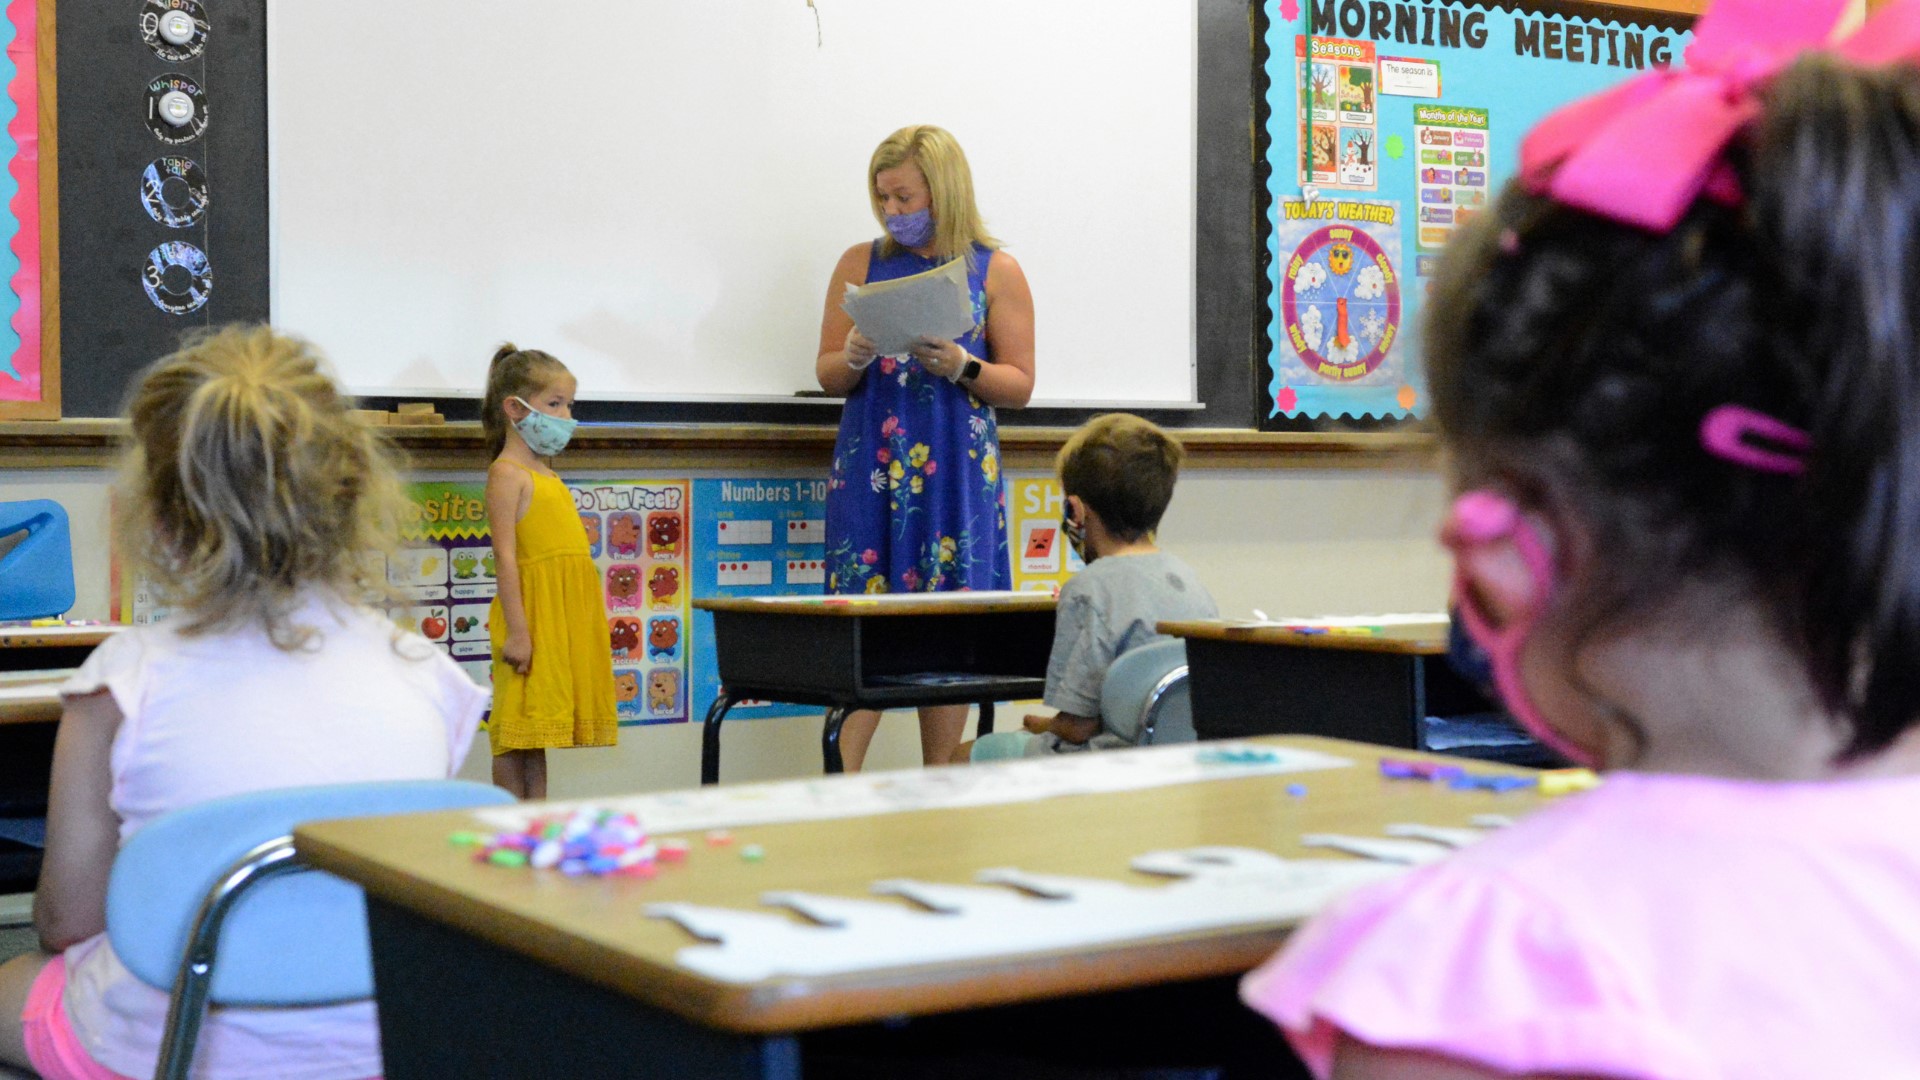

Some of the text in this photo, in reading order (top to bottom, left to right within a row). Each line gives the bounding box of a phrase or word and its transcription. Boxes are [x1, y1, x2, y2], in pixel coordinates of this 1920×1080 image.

[143, 12, 159, 35] 0
[1311, 0, 1673, 72] MORNING MEETING
[1312, 40, 1361, 57] Seasons
[1386, 64, 1433, 76] The season is
[1419, 110, 1485, 124] Months of the Year
[1433, 134, 1450, 142] January
[145, 179, 160, 203] 2
[1337, 202, 1395, 225] WEATHER
[1329, 228, 1353, 242] sunny
[147, 265, 160, 288] 3
[1288, 254, 1304, 280] rainy
[1376, 253, 1393, 284] cloudy
[1289, 323, 1307, 353] windy
[1379, 323, 1396, 353] snowy
[1319, 362, 1367, 380] partly sunny
[569, 487, 595, 510] Do
[594, 486, 632, 511] You
[721, 480, 827, 502] Numbers 1-10
[1023, 483, 1065, 514] SH
[454, 588, 475, 597] happy
